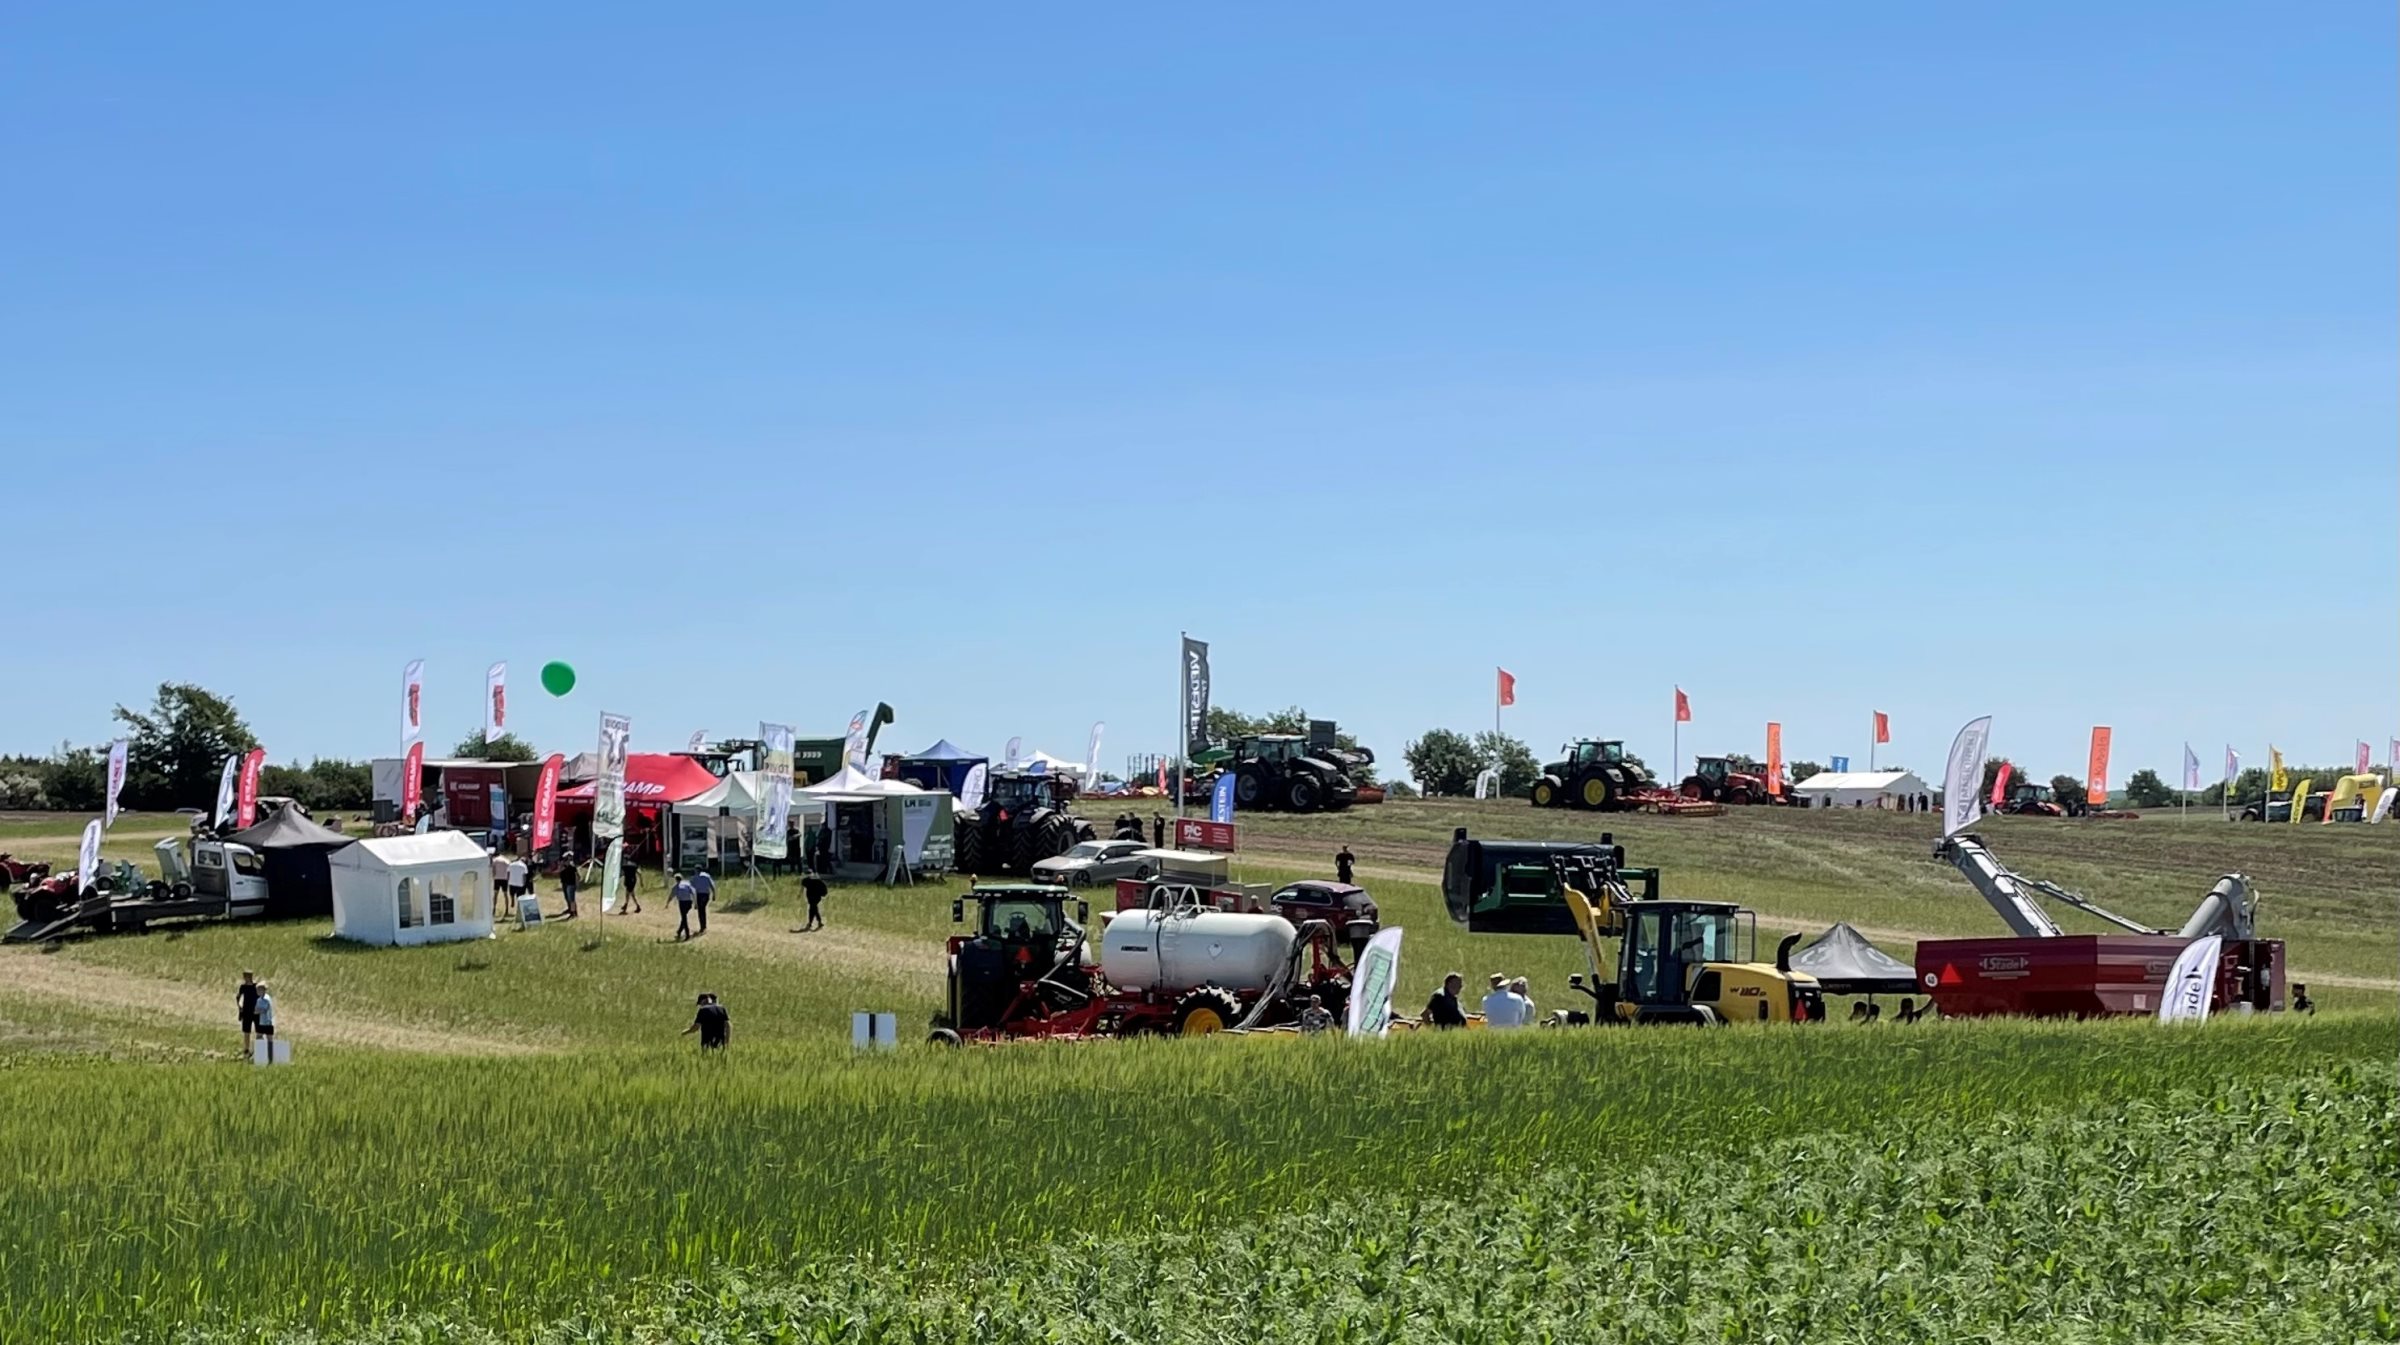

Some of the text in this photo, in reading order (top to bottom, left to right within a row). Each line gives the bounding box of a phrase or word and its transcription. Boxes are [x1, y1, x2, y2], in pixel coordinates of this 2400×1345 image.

[408, 755, 417, 799] KRAMP
[2094, 736, 2107, 776] Kubota
[245, 758, 257, 802] KRAMP
[541, 767, 554, 817] KRAMP
